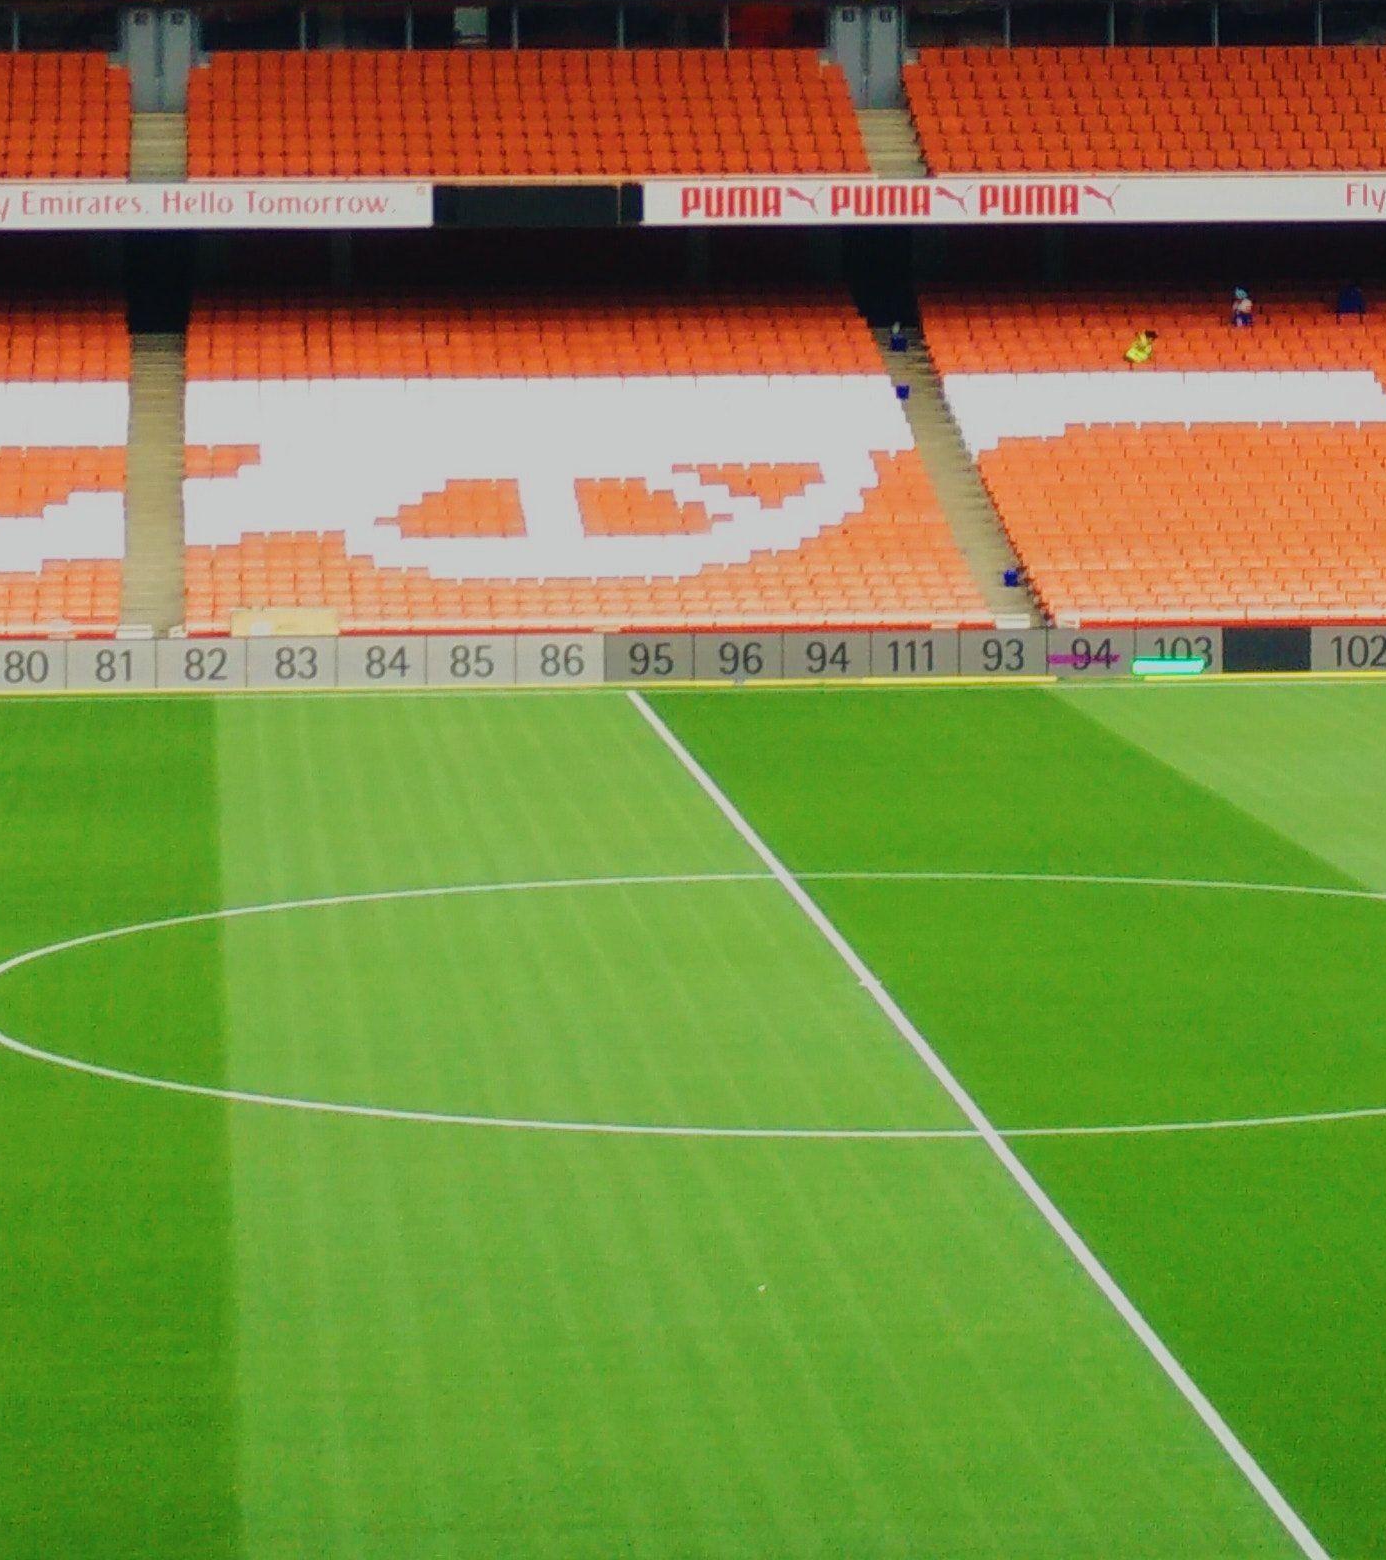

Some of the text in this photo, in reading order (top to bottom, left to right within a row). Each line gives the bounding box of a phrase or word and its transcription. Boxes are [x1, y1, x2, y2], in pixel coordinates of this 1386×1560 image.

[162, 189, 234, 215] Hello
[680, 184, 1079, 219] PUMA PUMA PUMA
[1345, 182, 1386, 213] Fly
[5, 651, 50, 685] 80
[96, 650, 133, 684] 81
[185, 648, 228, 682] 82
[276, 647, 319, 681] 83
[366, 646, 411, 680] 84
[450, 645, 496, 679] 85
[541, 644, 586, 678] 86
[629, 643, 675, 677] 95
[719, 642, 764, 676] 96
[807, 642, 851, 675] 94
[888, 641, 934, 673] 111
[983, 639, 1025, 673] 93
[1071, 638, 1113, 671] 94
